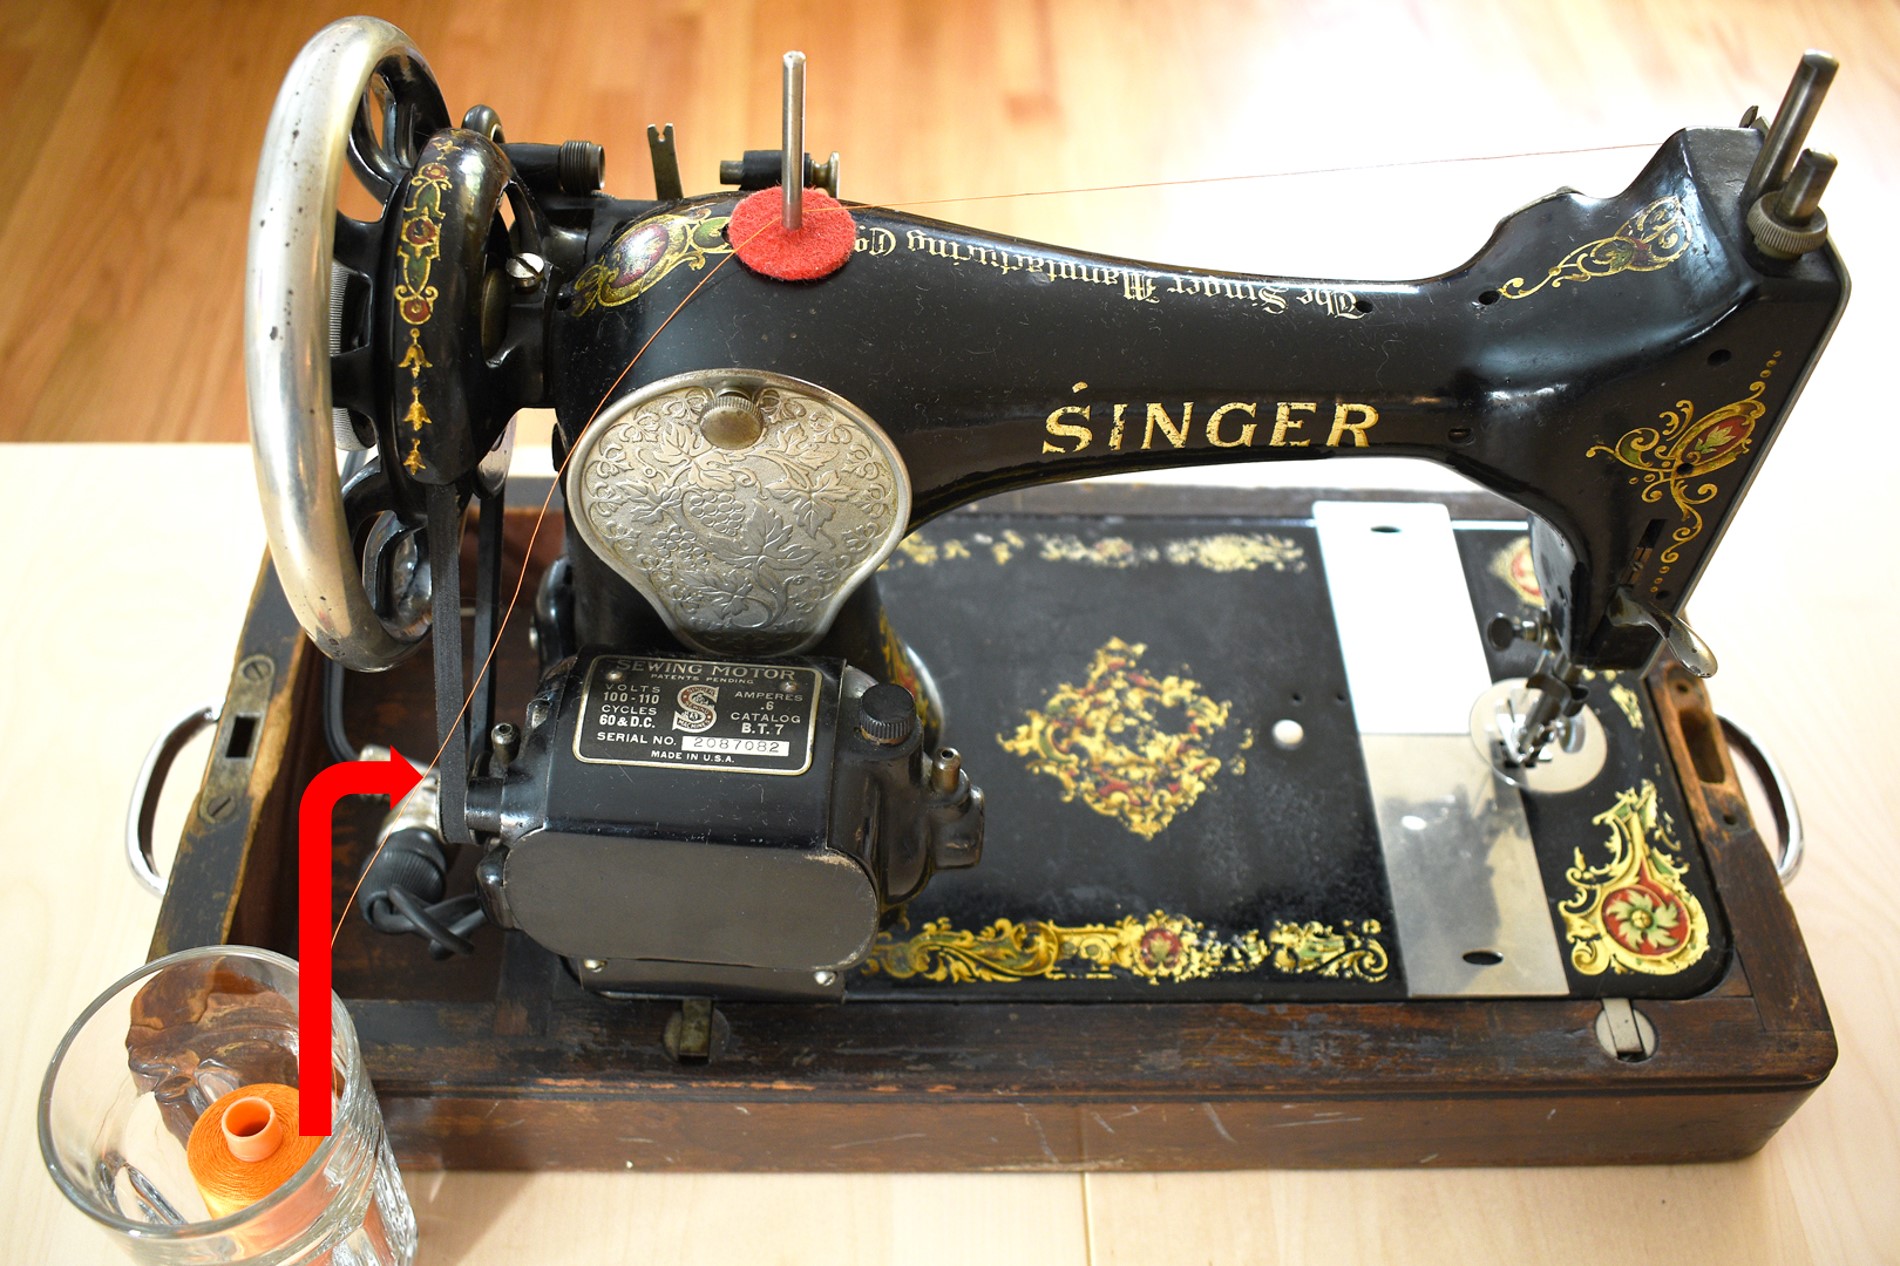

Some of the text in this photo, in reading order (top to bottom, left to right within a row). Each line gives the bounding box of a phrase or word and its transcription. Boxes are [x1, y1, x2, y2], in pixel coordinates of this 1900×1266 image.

[1167, 276, 1289, 315] Singer
[1296, 288, 1365, 320] The
[1042, 401, 1379, 455] SINGER
[616, 660, 796, 681] SEWING MOTOR
[650, 674, 754, 685] PATENTS PENDING
[604, 683, 661, 694] VOLTS
[734, 690, 804, 702] AMPERES
[601, 704, 657, 716] CYCLES
[730, 712, 801, 724] CATALOG
[596, 731, 780, 753] SERIAL NO. 2087082
[650, 750, 735, 763] MADE IN U.S.A.
